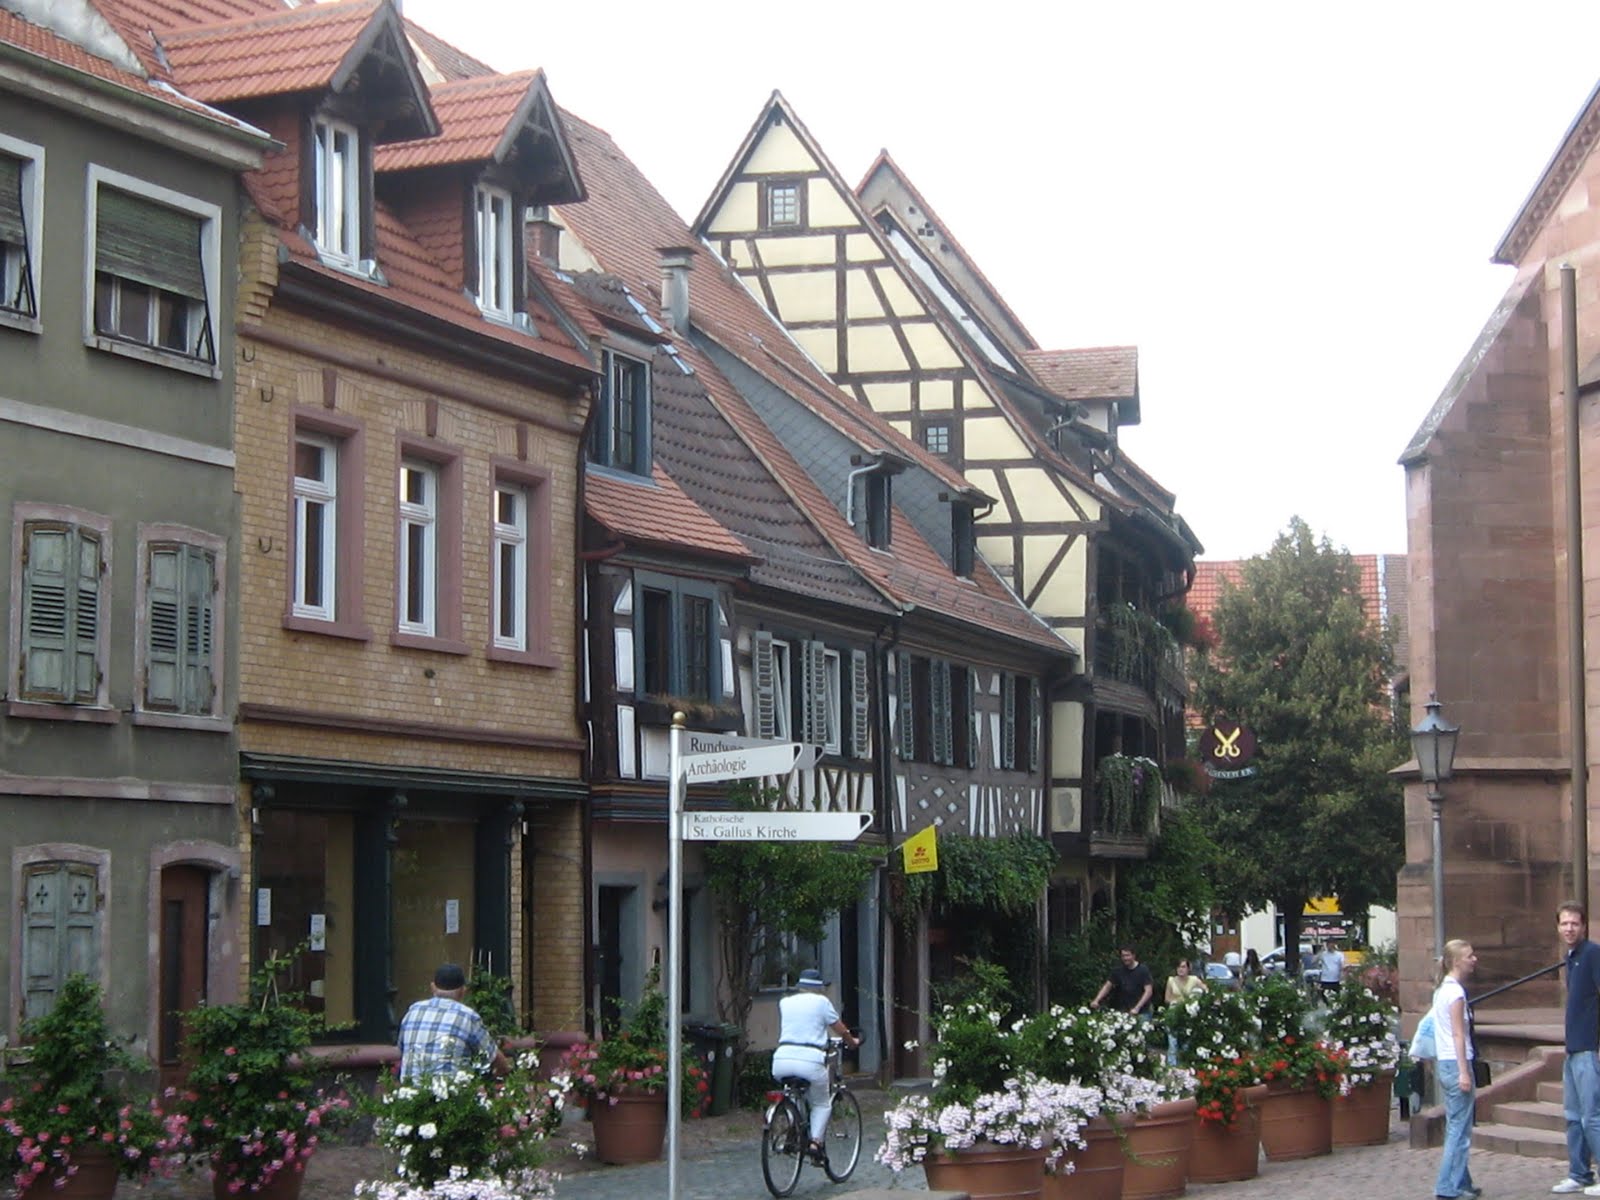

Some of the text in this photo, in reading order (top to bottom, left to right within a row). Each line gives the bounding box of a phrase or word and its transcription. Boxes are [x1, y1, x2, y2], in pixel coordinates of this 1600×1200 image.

[690, 737, 744, 753] Rundw
[687, 758, 747, 776] Archäologie
[694, 814, 744, 824] Katholische
[693, 825, 797, 838] St. Gallus Kirche
